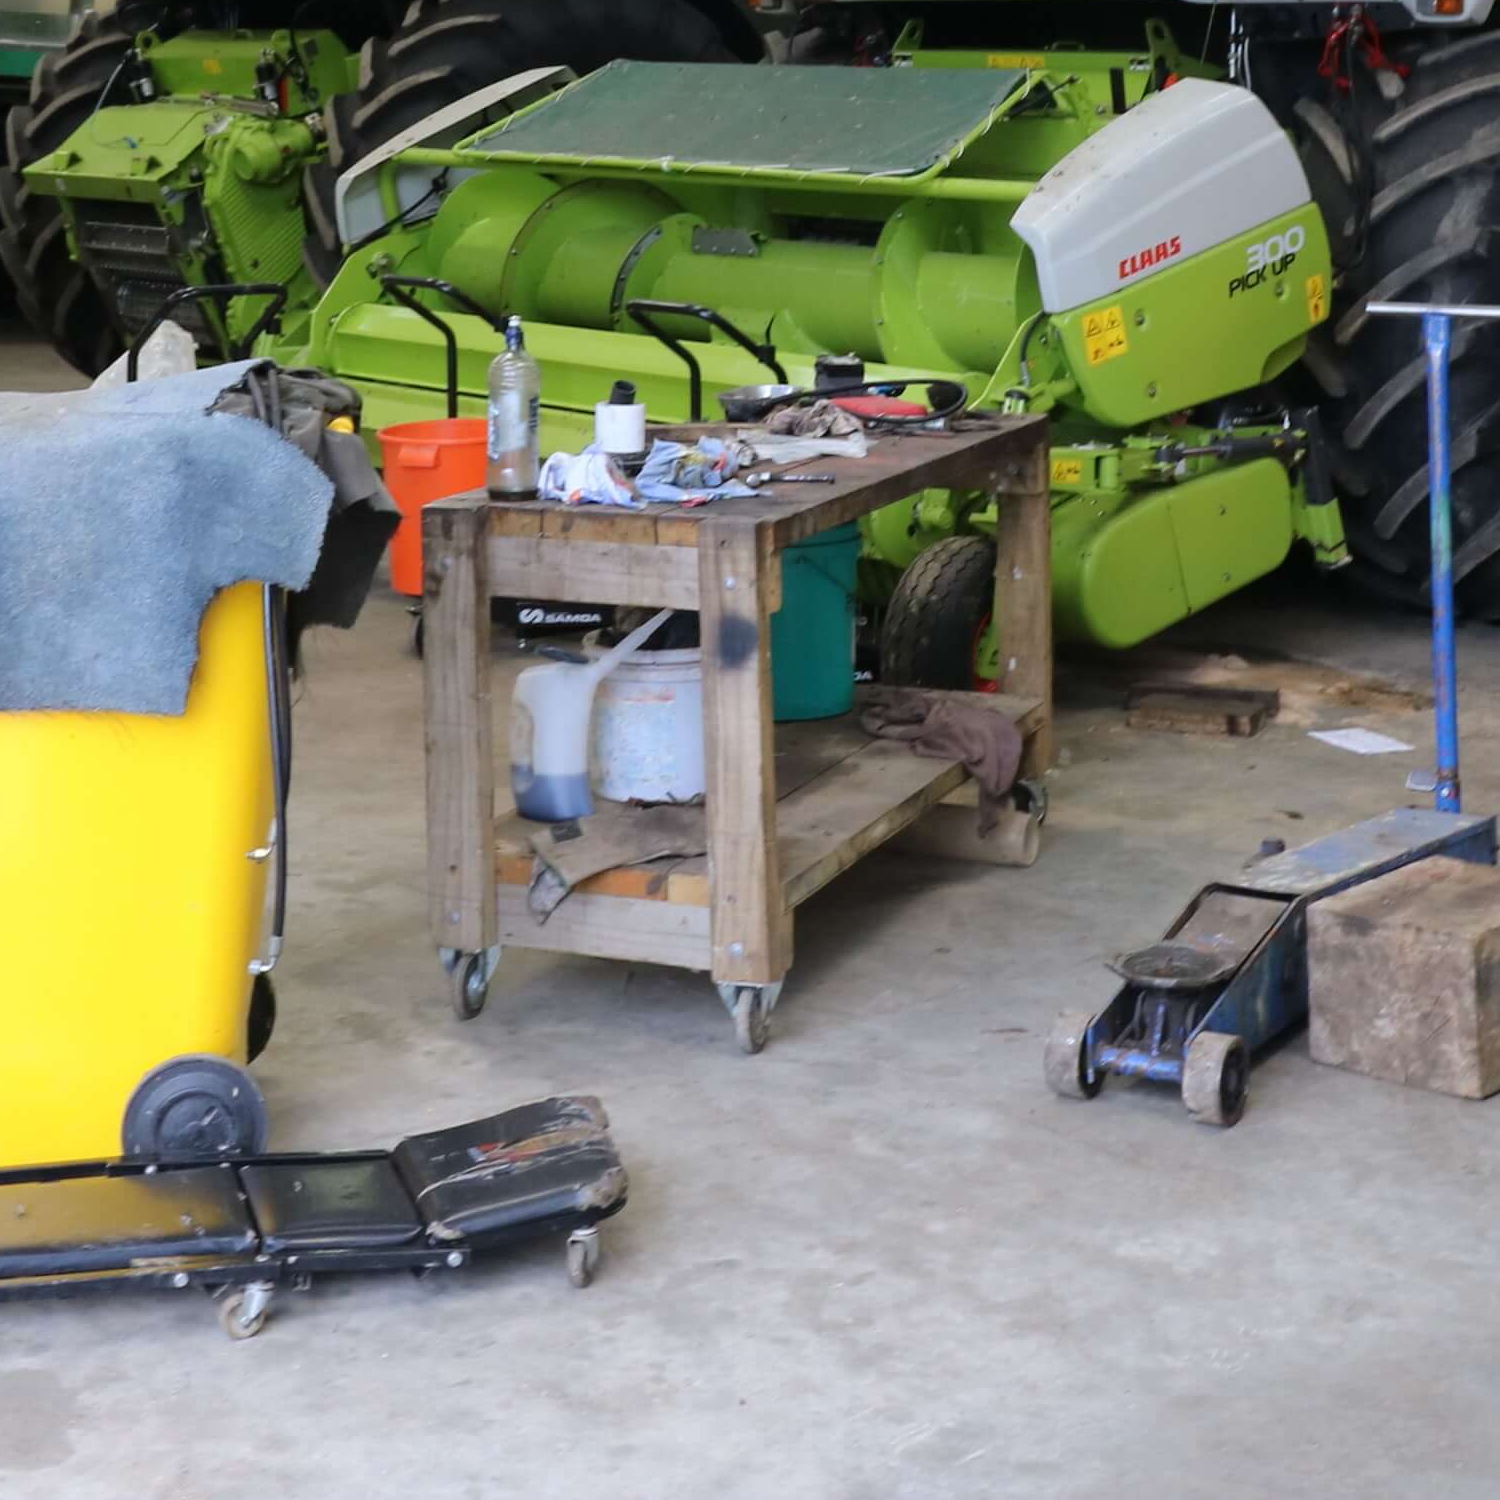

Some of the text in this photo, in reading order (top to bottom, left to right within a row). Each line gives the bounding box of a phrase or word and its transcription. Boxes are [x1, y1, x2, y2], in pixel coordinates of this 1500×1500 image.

[1119, 236, 1181, 280] CLAAS
[1247, 226, 1304, 274] 300
[1229, 253, 1296, 298] PICK UP
